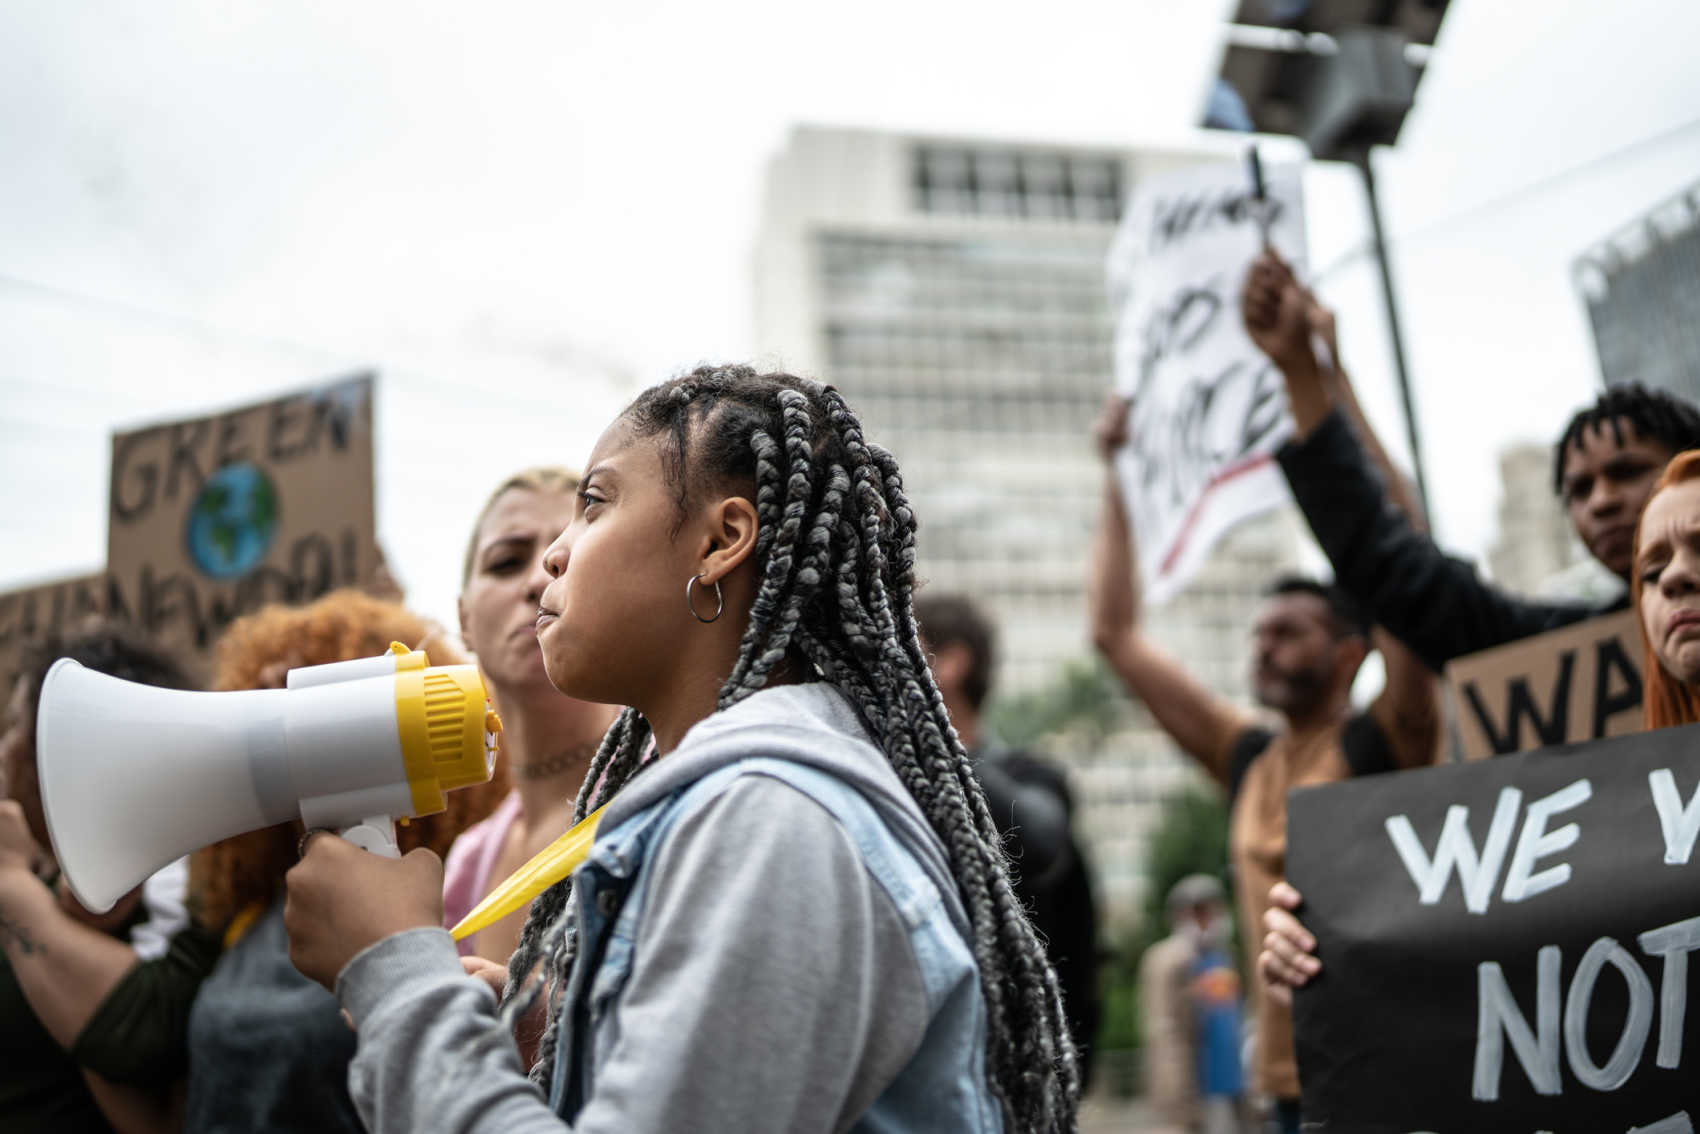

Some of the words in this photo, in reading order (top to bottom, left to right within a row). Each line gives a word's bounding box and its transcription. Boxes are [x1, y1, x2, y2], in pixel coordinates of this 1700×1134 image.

[112, 393, 356, 523] GREEN
[1385, 778, 1593, 914] WE
[1472, 916, 1700, 1100] NOT
